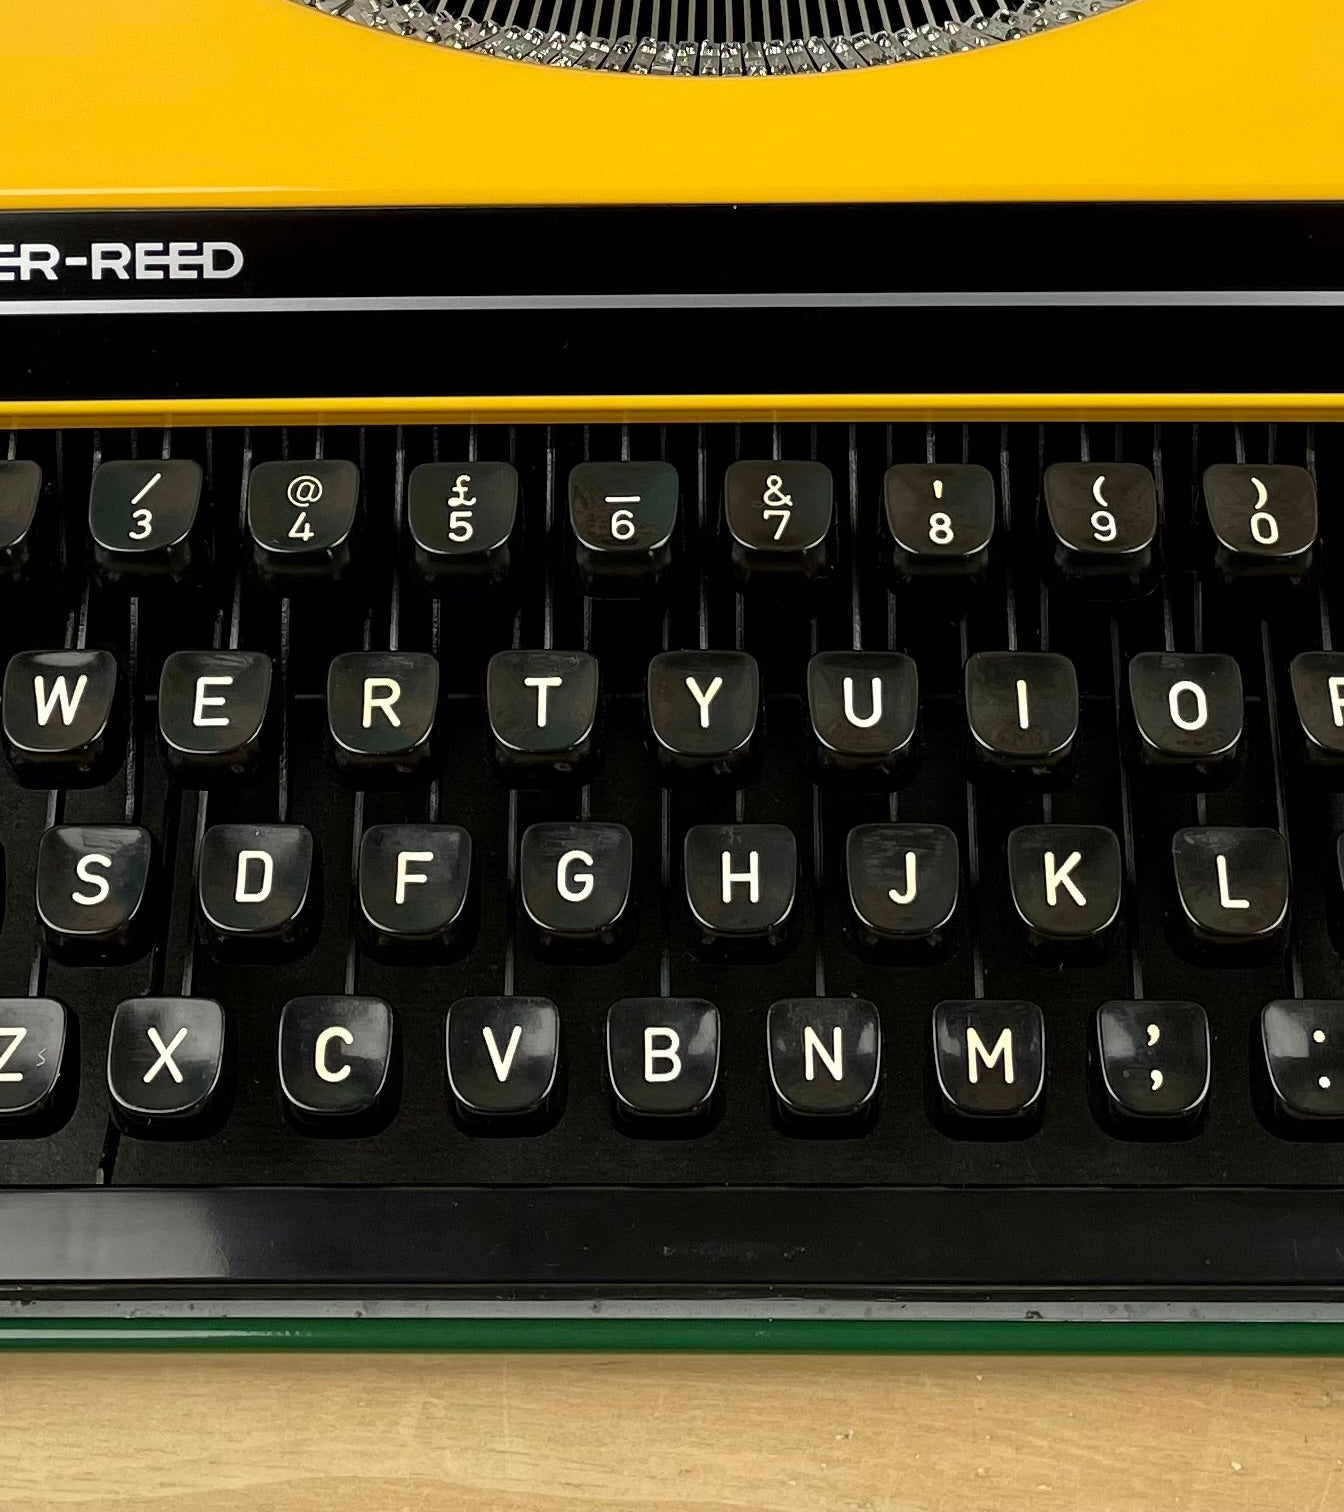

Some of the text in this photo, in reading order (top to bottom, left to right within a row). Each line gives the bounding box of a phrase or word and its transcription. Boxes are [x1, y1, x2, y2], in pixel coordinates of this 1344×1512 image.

[287, 475, 323, 508] @
[447, 474, 477, 507] £
[763, 474, 793, 507] &
[1092, 475, 1108, 507] (
[1251, 477, 1268, 510] )
[128, 508, 153, 540] 3
[288, 511, 315, 542] 4
[448, 510, 474, 542] 5
[611, 509, 635, 540] 6
[763, 509, 791, 540] 7
[928, 512, 954, 545] 8
[1090, 510, 1117, 542] 9
[1250, 511, 1279, 545] 0
[34, 674, 88, 726] W
[192, 676, 234, 727] E
[362, 677, 401, 728] R
[524, 676, 563, 728] T
[685, 676, 723, 728] Y
[843, 676, 883, 728] U
[1016, 679, 1029, 730] I
[1168, 680, 1208, 731] O
[71, 853, 112, 906] S
[235, 850, 274, 903] D
[395, 851, 434, 905] F
[557, 849, 594, 902] G
[721, 850, 760, 904] H
[888, 851, 917, 905] J
[1044, 851, 1087, 906] K
[1216, 854, 1250, 909] L
[143, 1023, 191, 1083] X
[314, 1026, 354, 1083] C
[482, 1025, 523, 1082] V
[644, 1027, 682, 1083] B
[804, 1026, 843, 1081] N
[966, 1027, 1014, 1084] M
